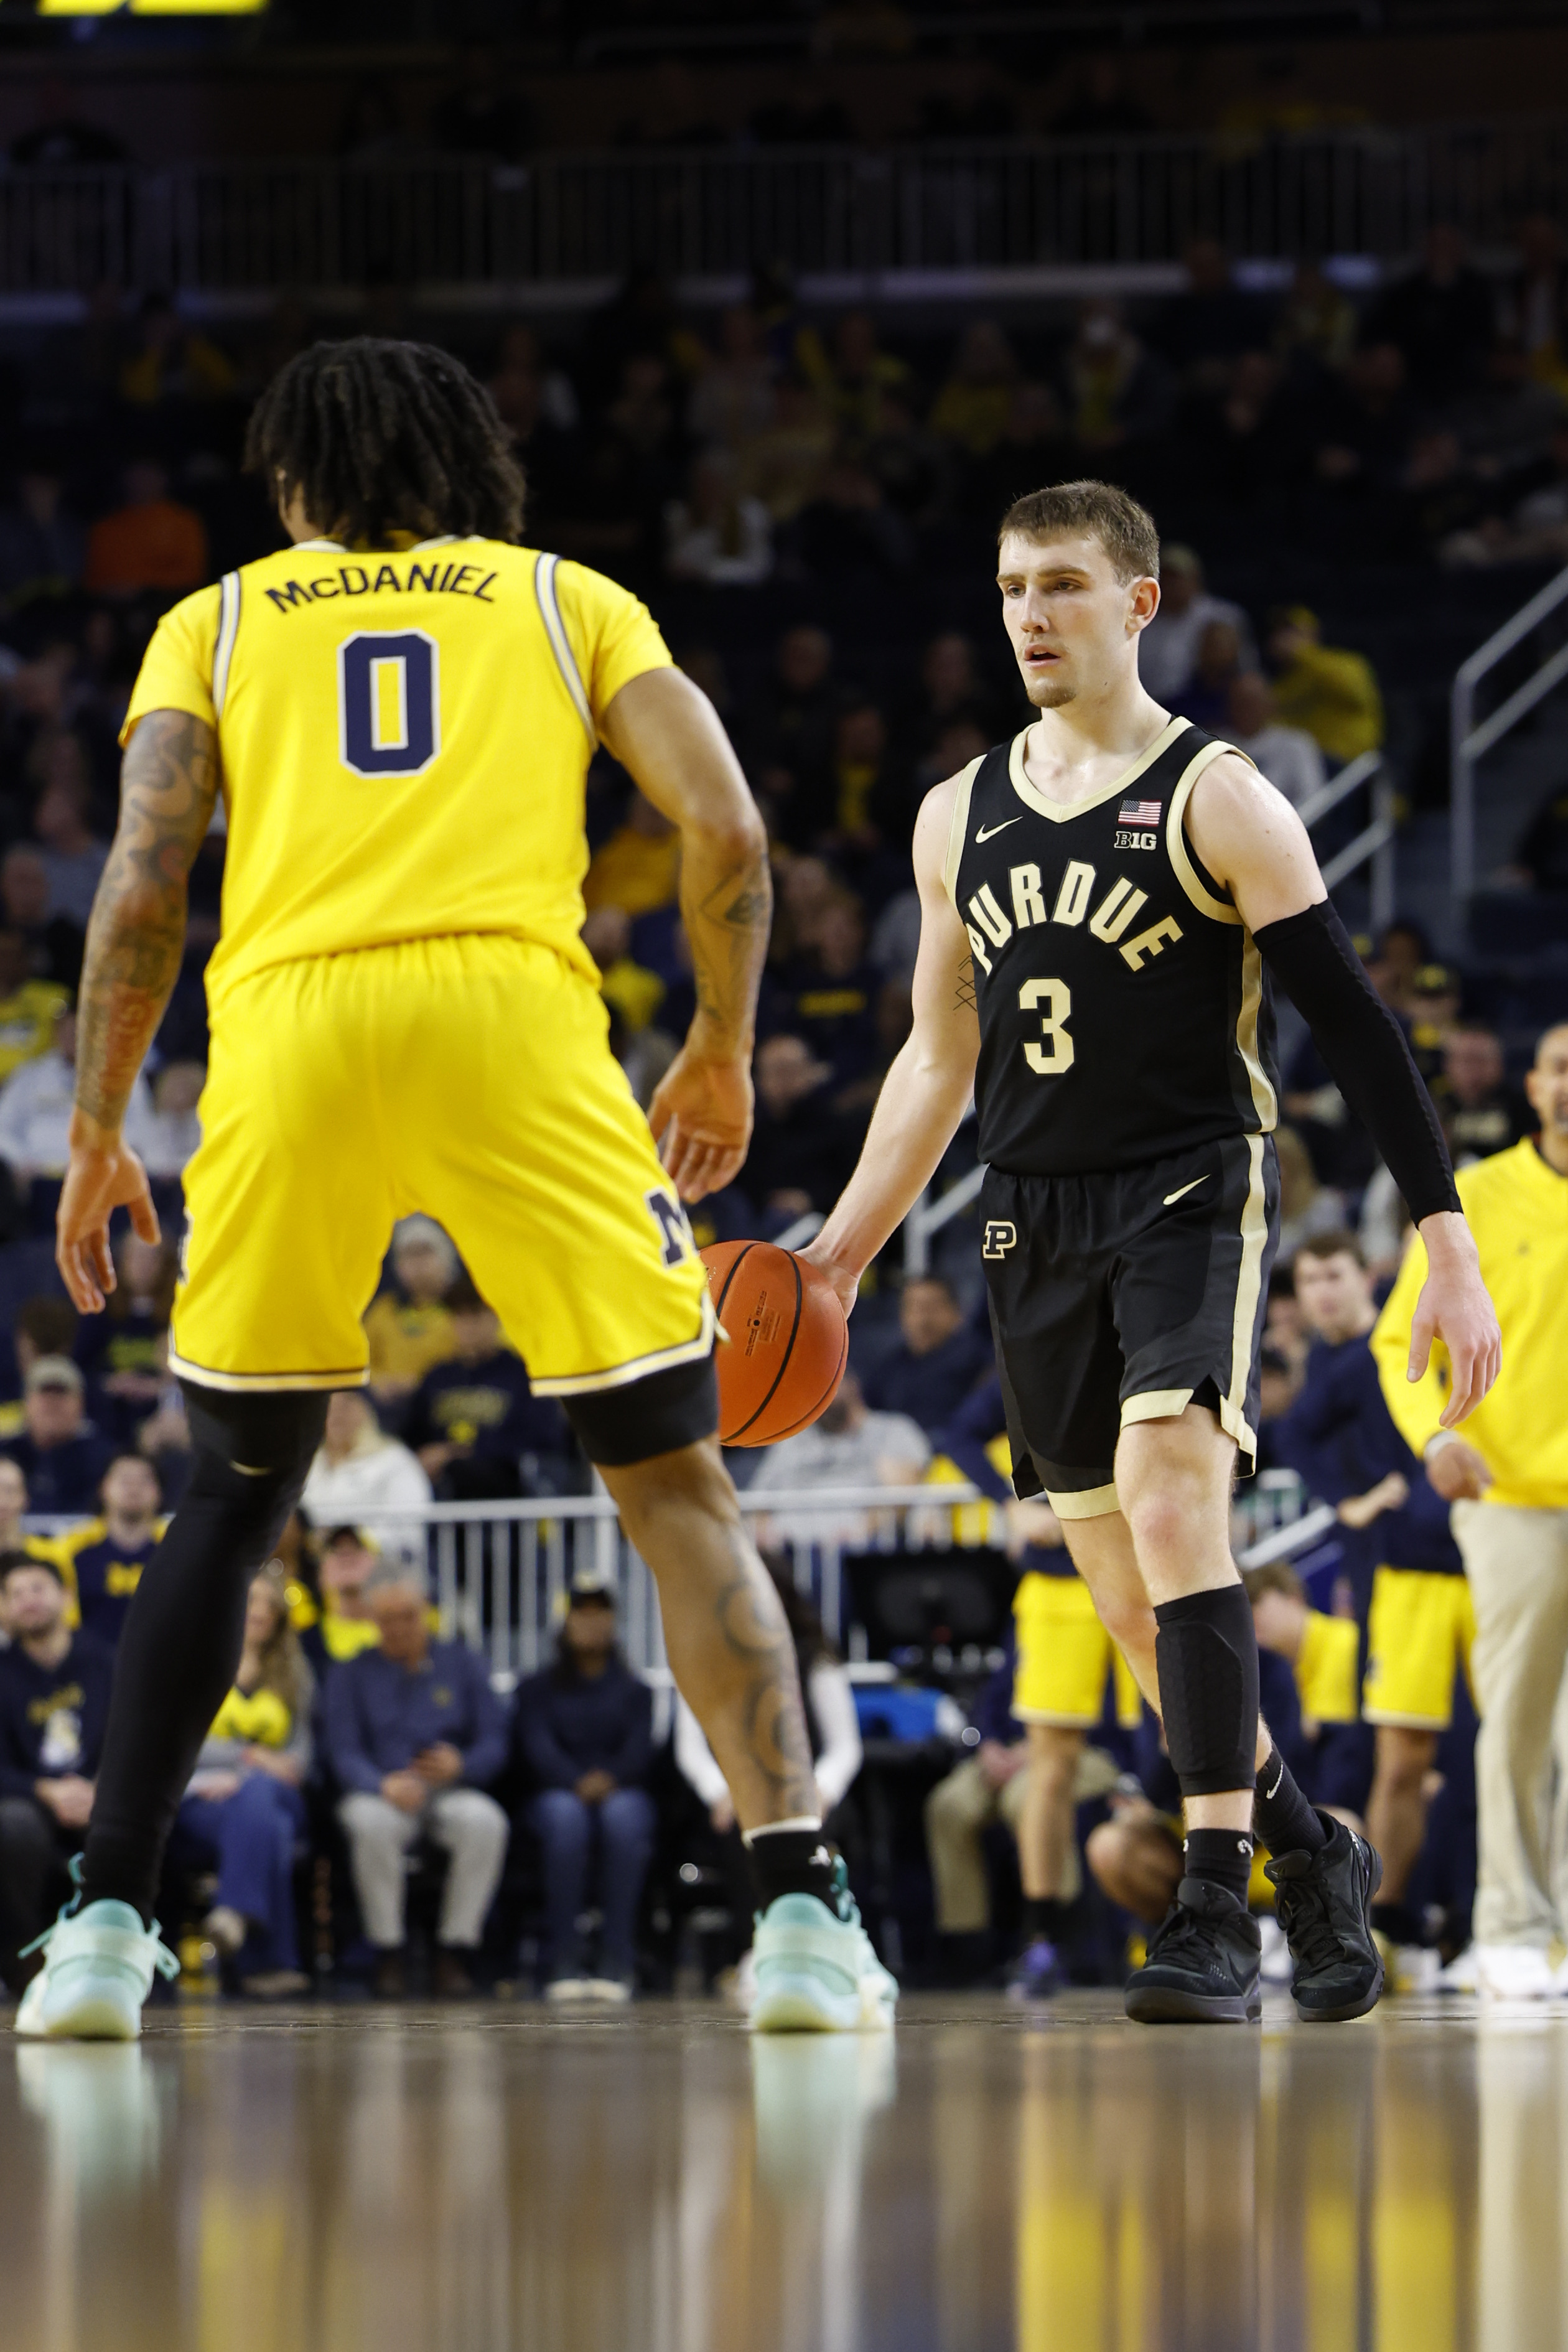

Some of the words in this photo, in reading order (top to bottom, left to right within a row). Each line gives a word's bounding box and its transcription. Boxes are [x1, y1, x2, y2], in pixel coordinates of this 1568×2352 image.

[264, 563, 498, 614] McDANIEL
[337, 628, 441, 780] 0
[965, 857, 1184, 977] PURDUE
[1017, 976, 1075, 1075] 3
[983, 1221, 1017, 1259] P
